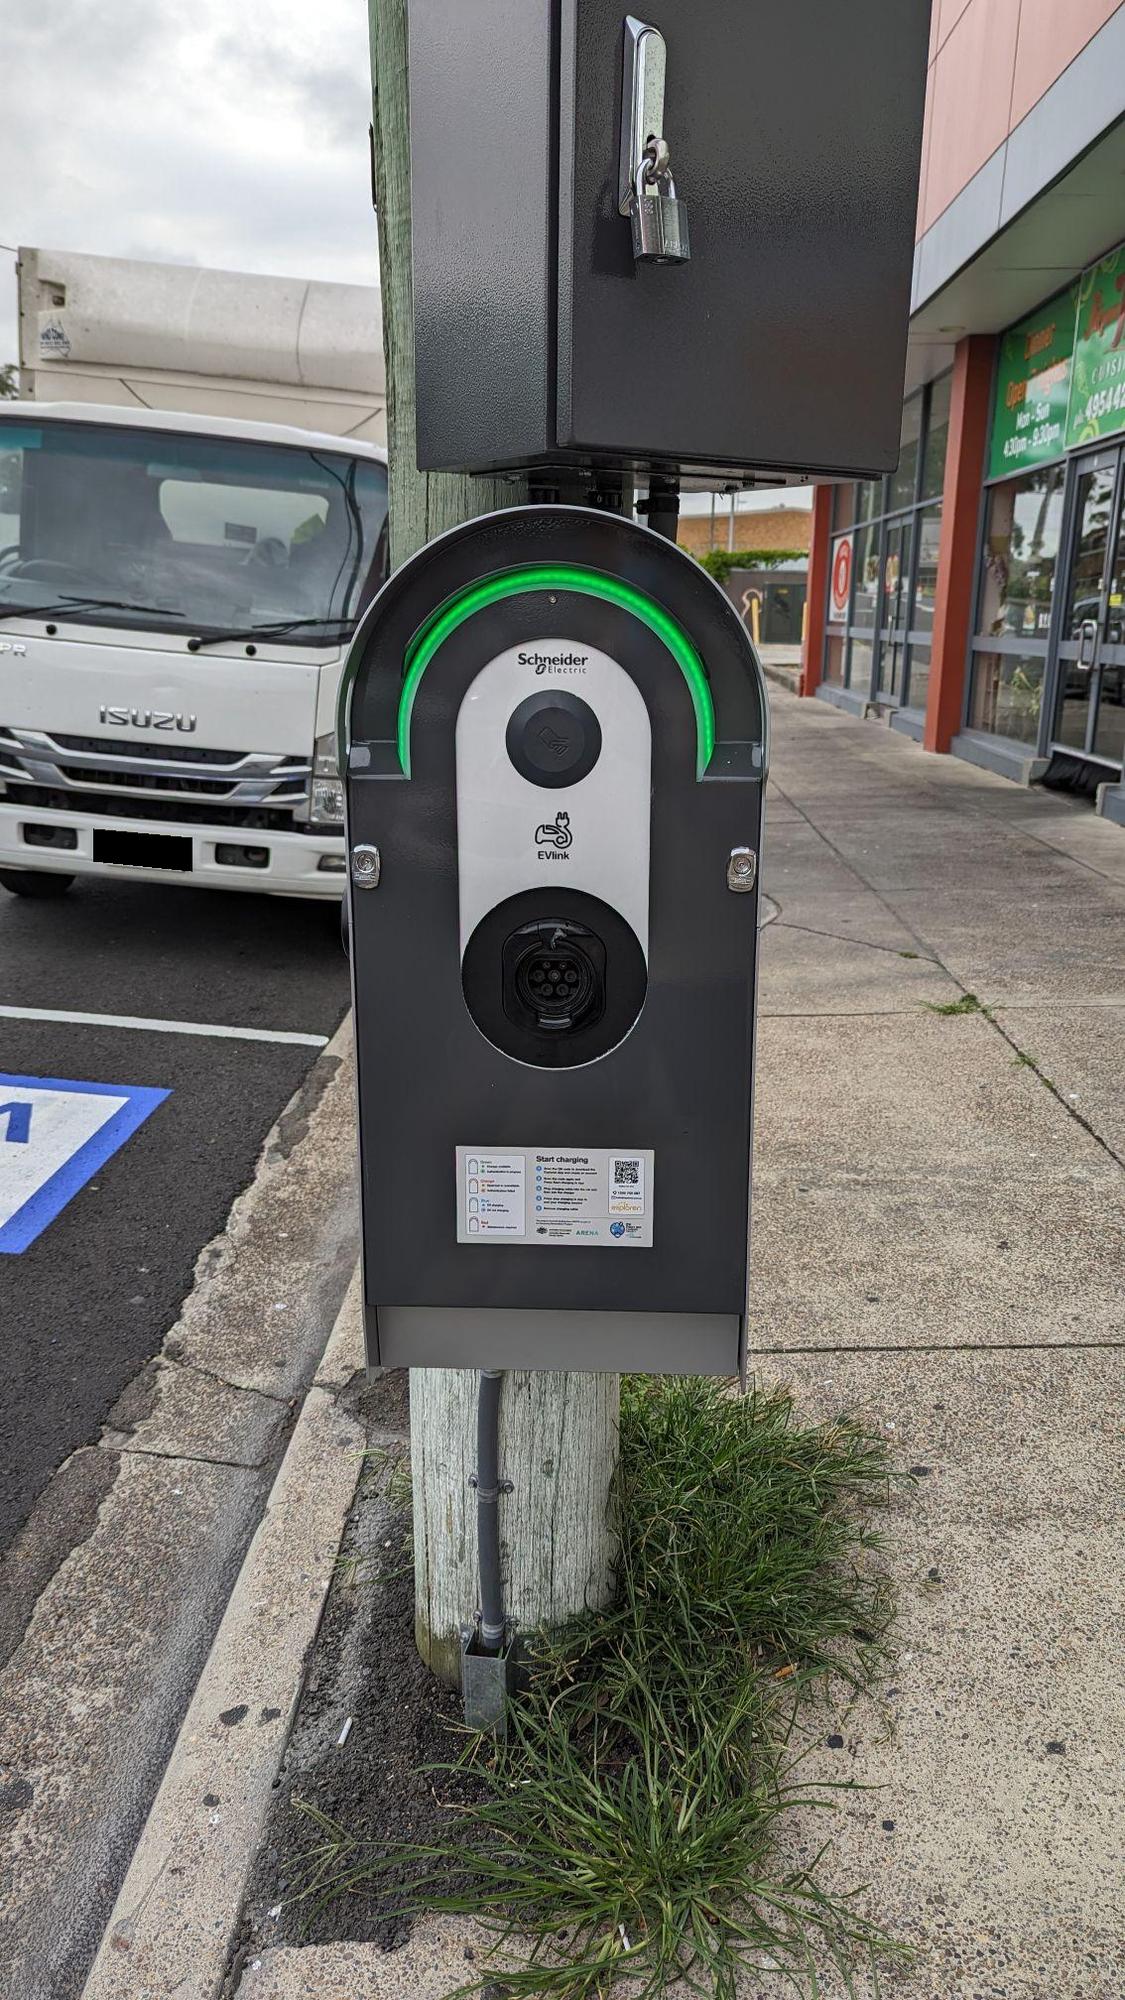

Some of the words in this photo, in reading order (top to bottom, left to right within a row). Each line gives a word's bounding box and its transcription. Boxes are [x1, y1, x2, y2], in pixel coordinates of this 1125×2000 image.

[518, 653, 589, 666] Schneider
[548, 666, 587, 675] Electric
[99, 704, 197, 733] ISUZU
[537, 850, 570, 860] EVlink
[536, 1155, 555, 1163] Start
[556, 1156, 589, 1165] charging
